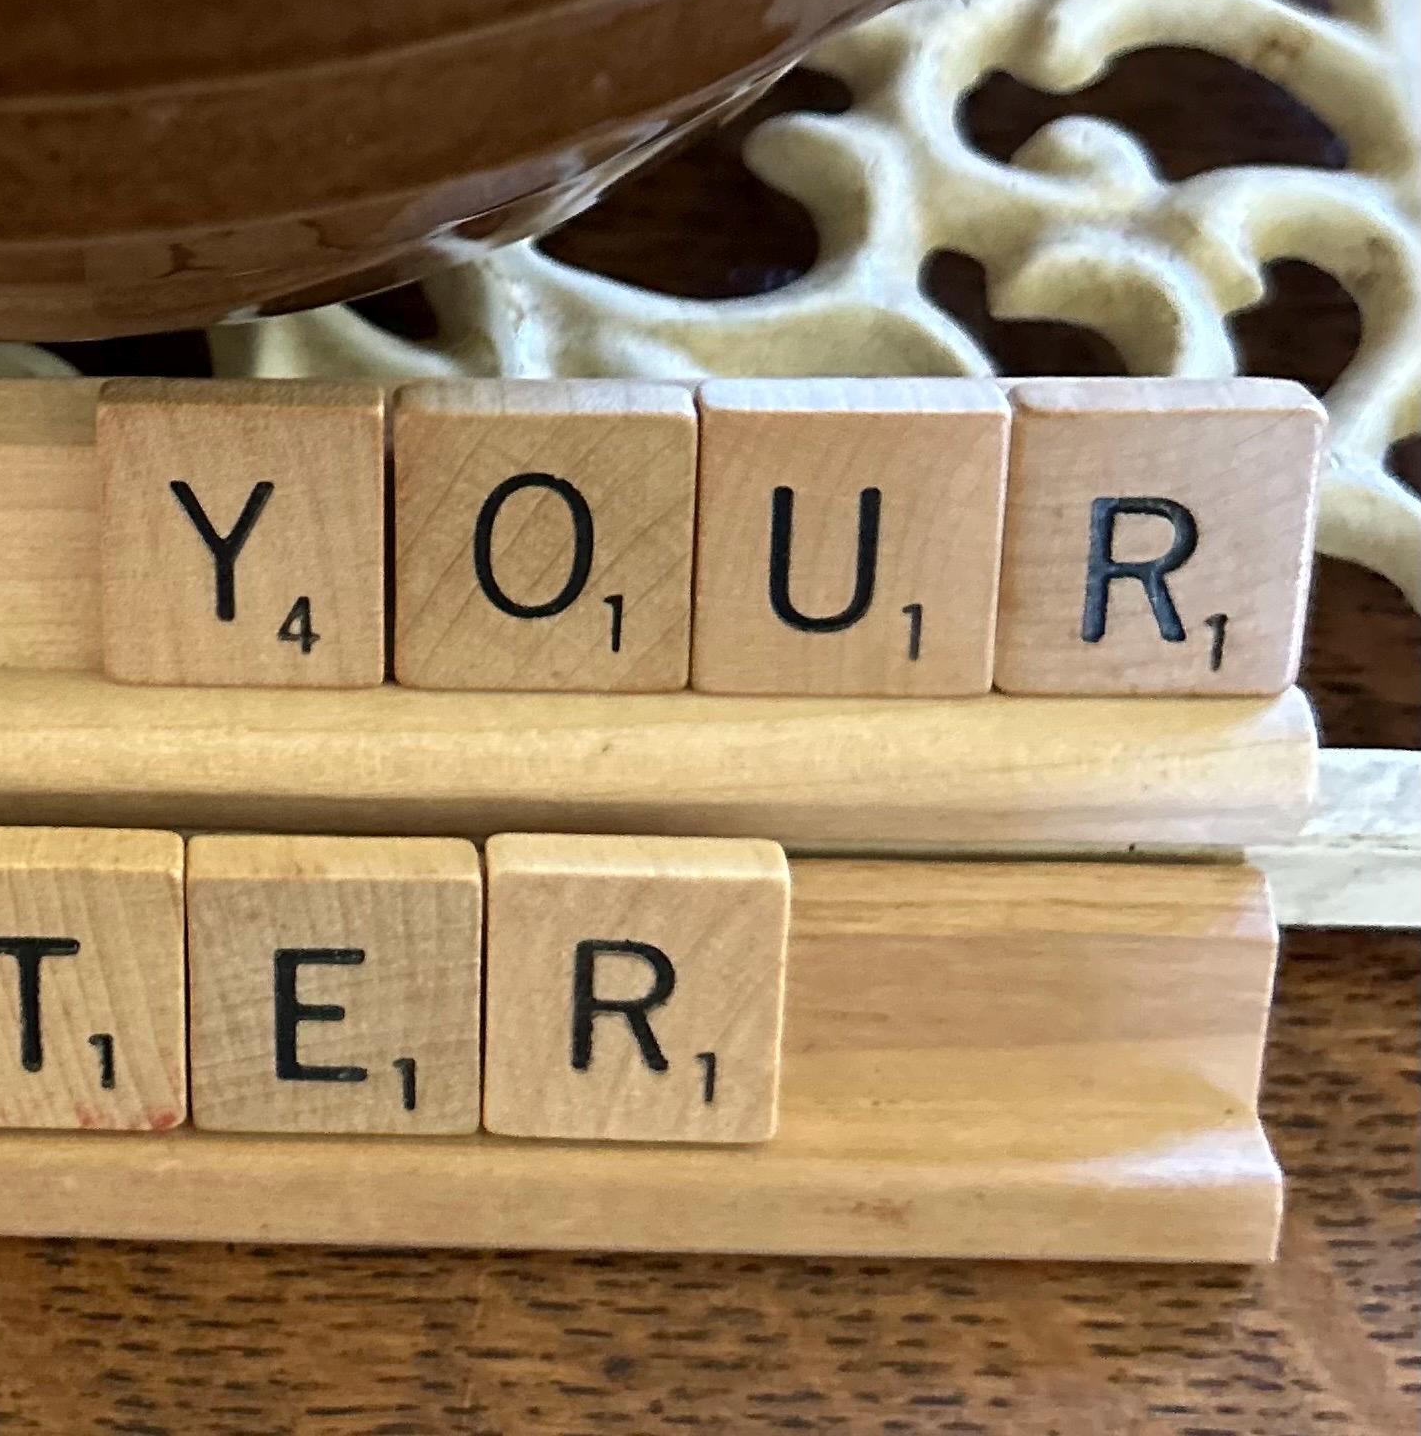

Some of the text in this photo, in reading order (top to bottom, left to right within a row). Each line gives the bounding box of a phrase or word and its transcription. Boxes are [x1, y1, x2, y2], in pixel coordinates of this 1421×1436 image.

[278, 596, 320, 654] 4
[603, 595, 623, 652] 1
[902, 604, 923, 661] 1
[1204, 614, 1228, 671] 1
[89, 1034, 115, 1089] 1
[393, 1058, 416, 1111] 1
[696, 1052, 716, 1105] 1
